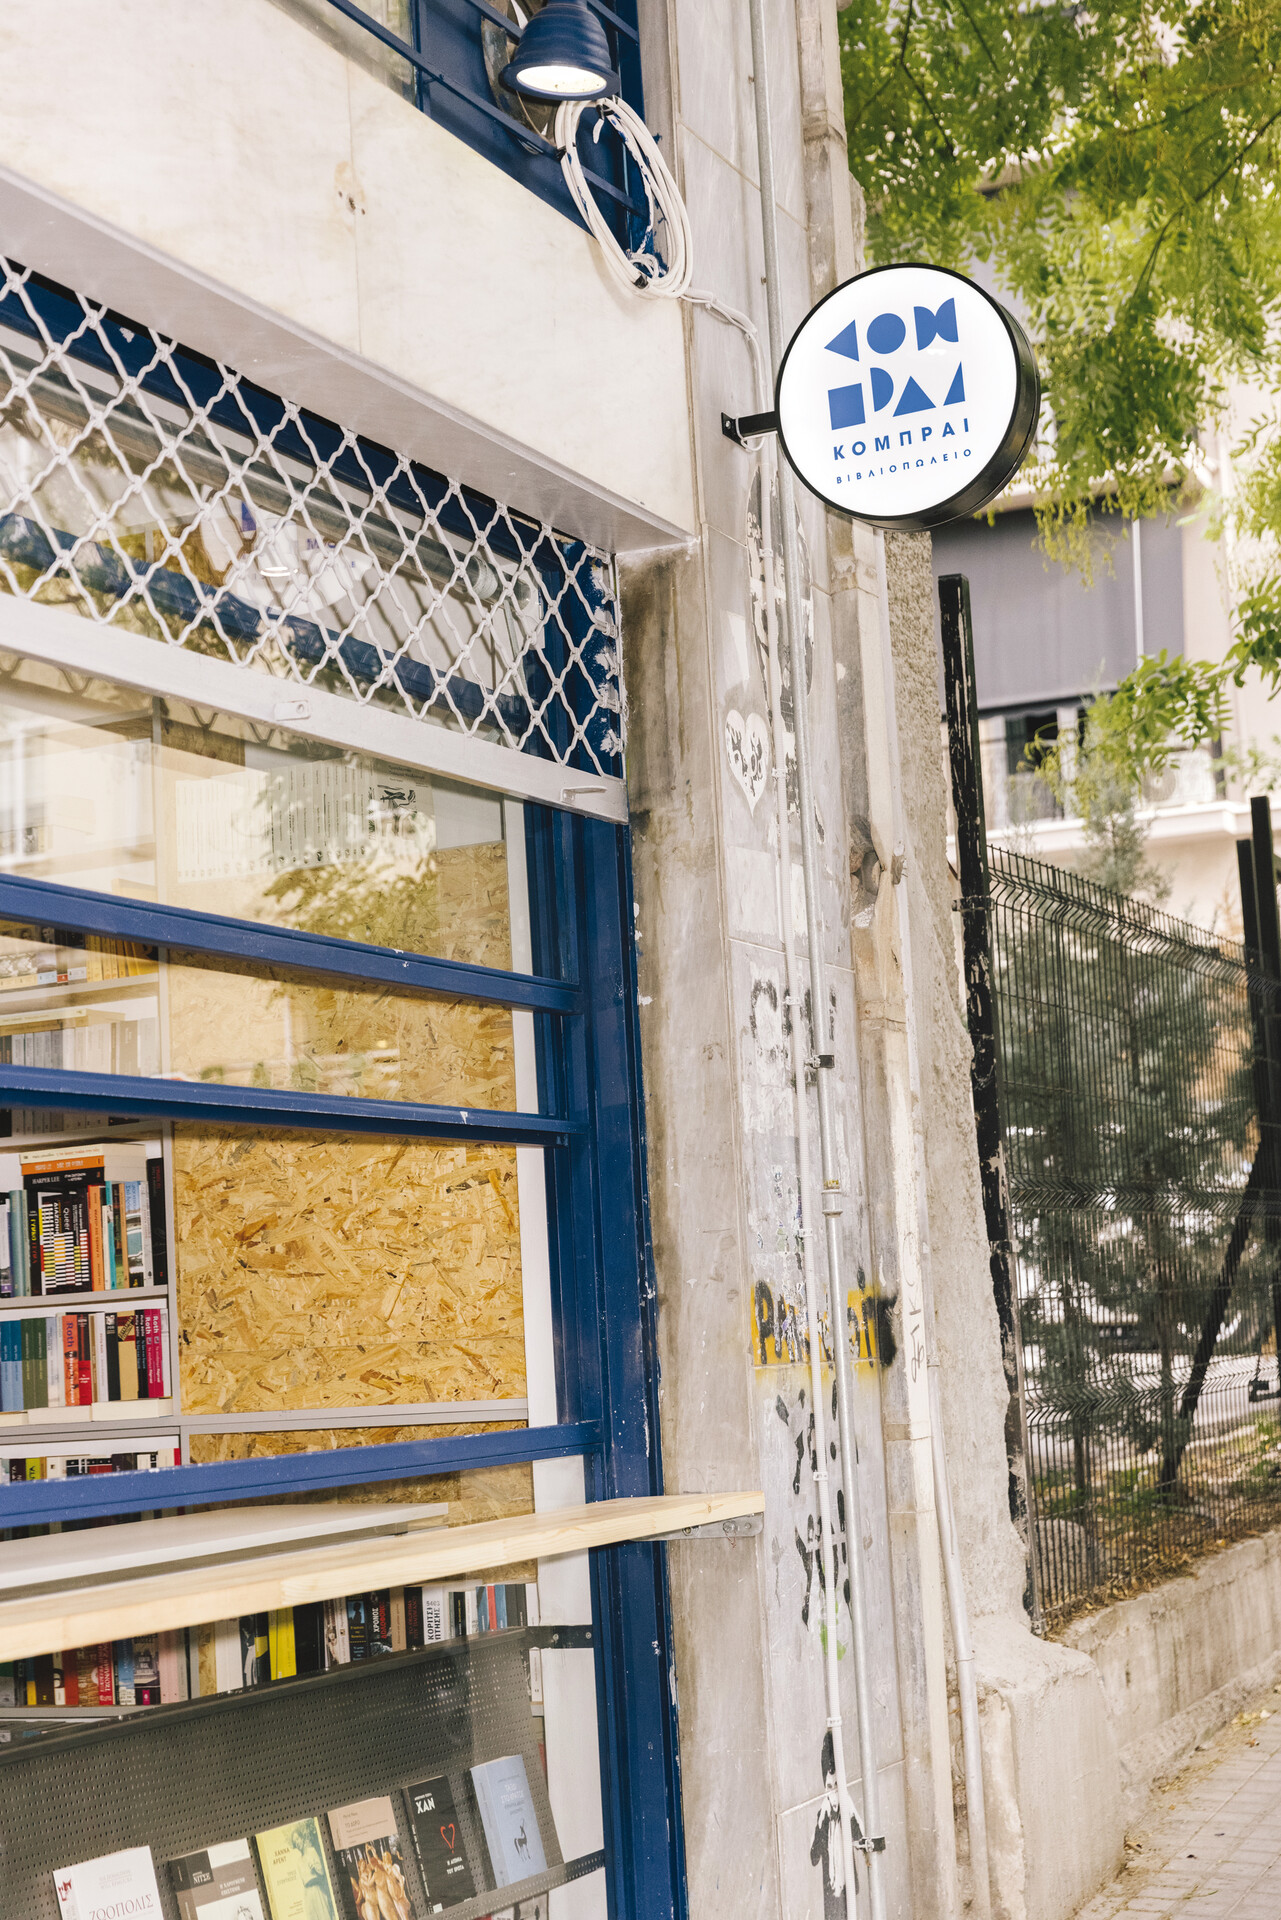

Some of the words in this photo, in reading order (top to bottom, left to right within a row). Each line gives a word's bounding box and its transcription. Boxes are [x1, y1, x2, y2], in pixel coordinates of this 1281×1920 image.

[833, 418, 969, 460] ΚΟΜΠΡΑΙ
[836, 449, 972, 484] ΒΙΒΛΙΟΠΩΛΕΙΟ
[66, 1322, 74, 1348] Roth
[372, 1607, 380, 1633] ΧΡΟΝΟΣ
[89, 1894, 154, 1920] ΖΩΟΠΟΛΙΣ
